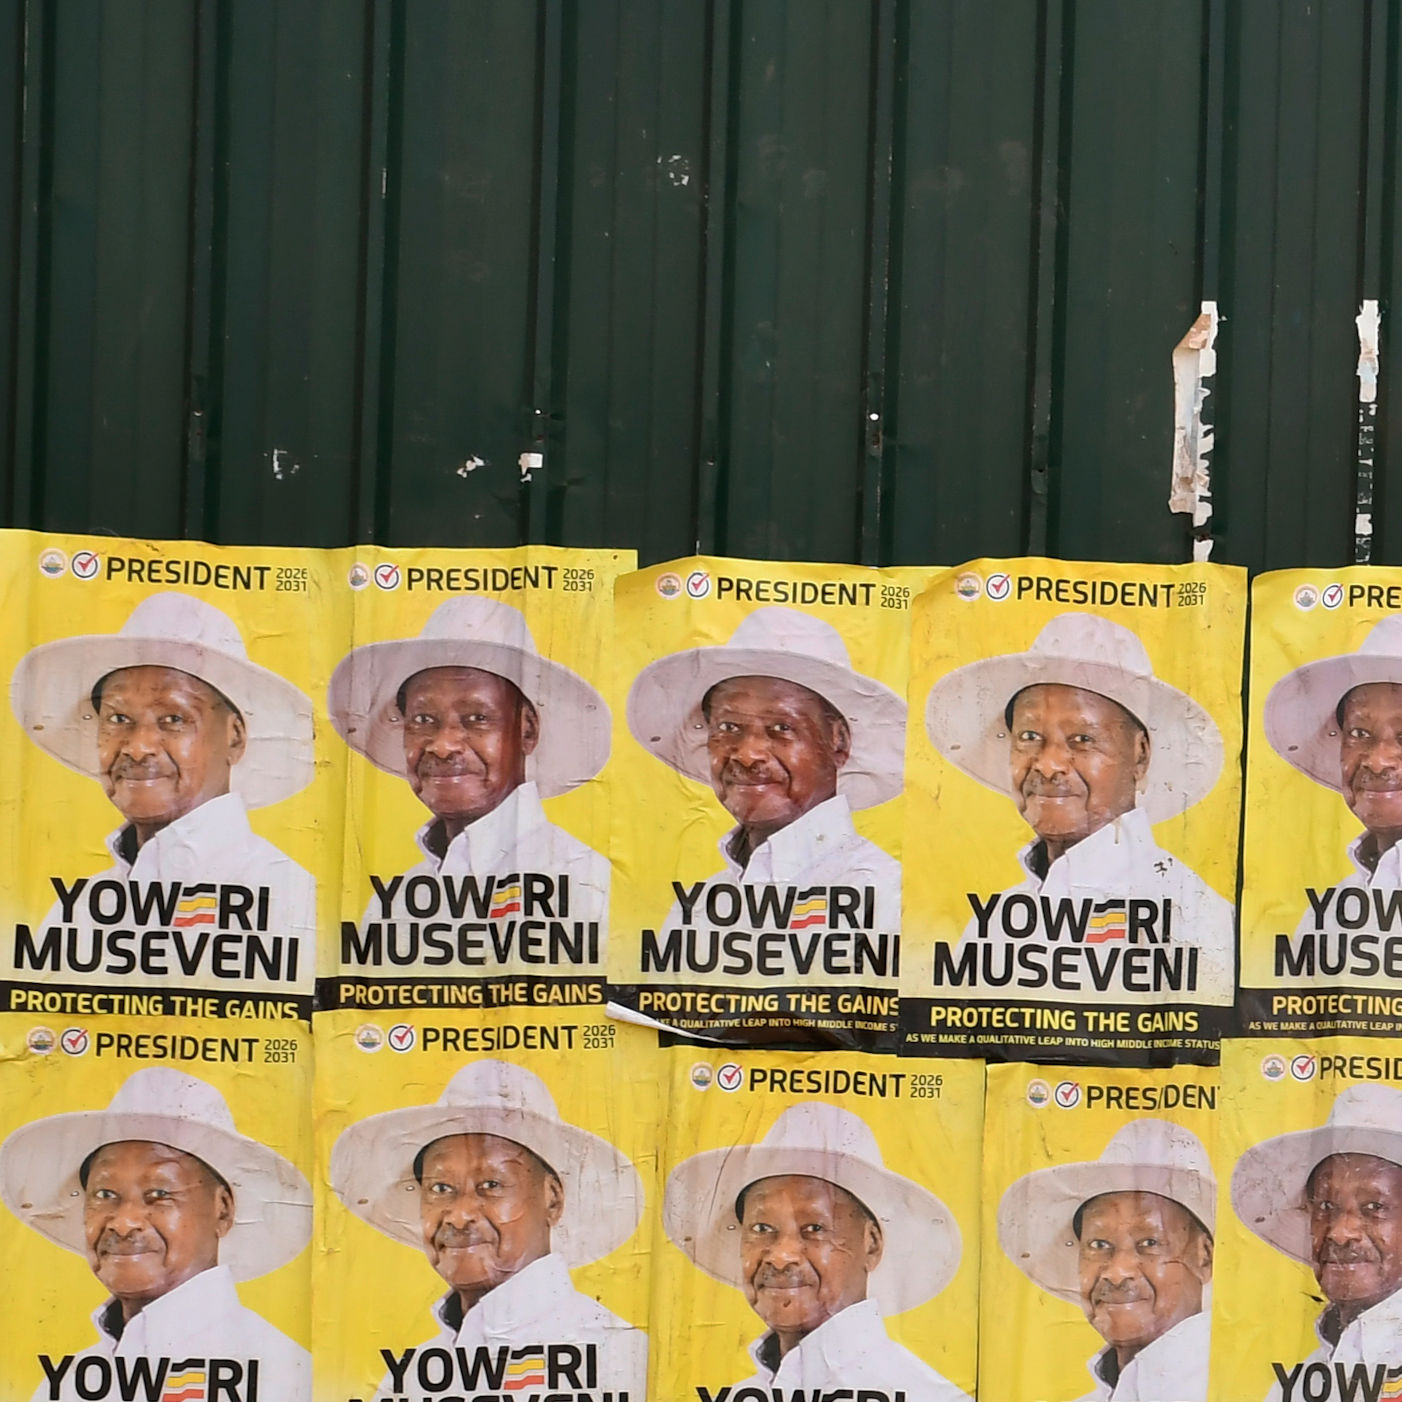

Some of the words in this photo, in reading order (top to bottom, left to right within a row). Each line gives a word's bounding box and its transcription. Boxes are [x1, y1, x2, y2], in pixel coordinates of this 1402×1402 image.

[407, 565, 558, 591] PRESIDENT
[562, 569, 595, 580] 2026
[562, 580, 593, 592] 2031
[717, 576, 875, 606] PRESIDENT
[881, 585, 910, 598] 2026
[881, 597, 909, 609] 2031
[369, 872, 569, 920] YOWERI
[967, 893, 1171, 943] YOWERI
[341, 921, 599, 968] MUSEVENI
[935, 942, 1198, 992] MUSEVENI
[340, 982, 483, 1005] PROTECTING
[488, 983, 528, 1002] THE
[533, 983, 602, 1004] GAINS
[583, 1024, 616, 1036] 2026
[931, 1007, 1076, 1031] PROTECTING
[1084, 1009, 1129, 1031] THE
[1137, 1011, 1198, 1032] GAINS
[423, 1025, 579, 1052] PRESIDENT
[584, 1037, 615, 1049] 2031
[750, 1068, 906, 1099] PRESIDENT
[910, 1074, 943, 1086] 2026
[910, 1086, 942, 1098] 2031
